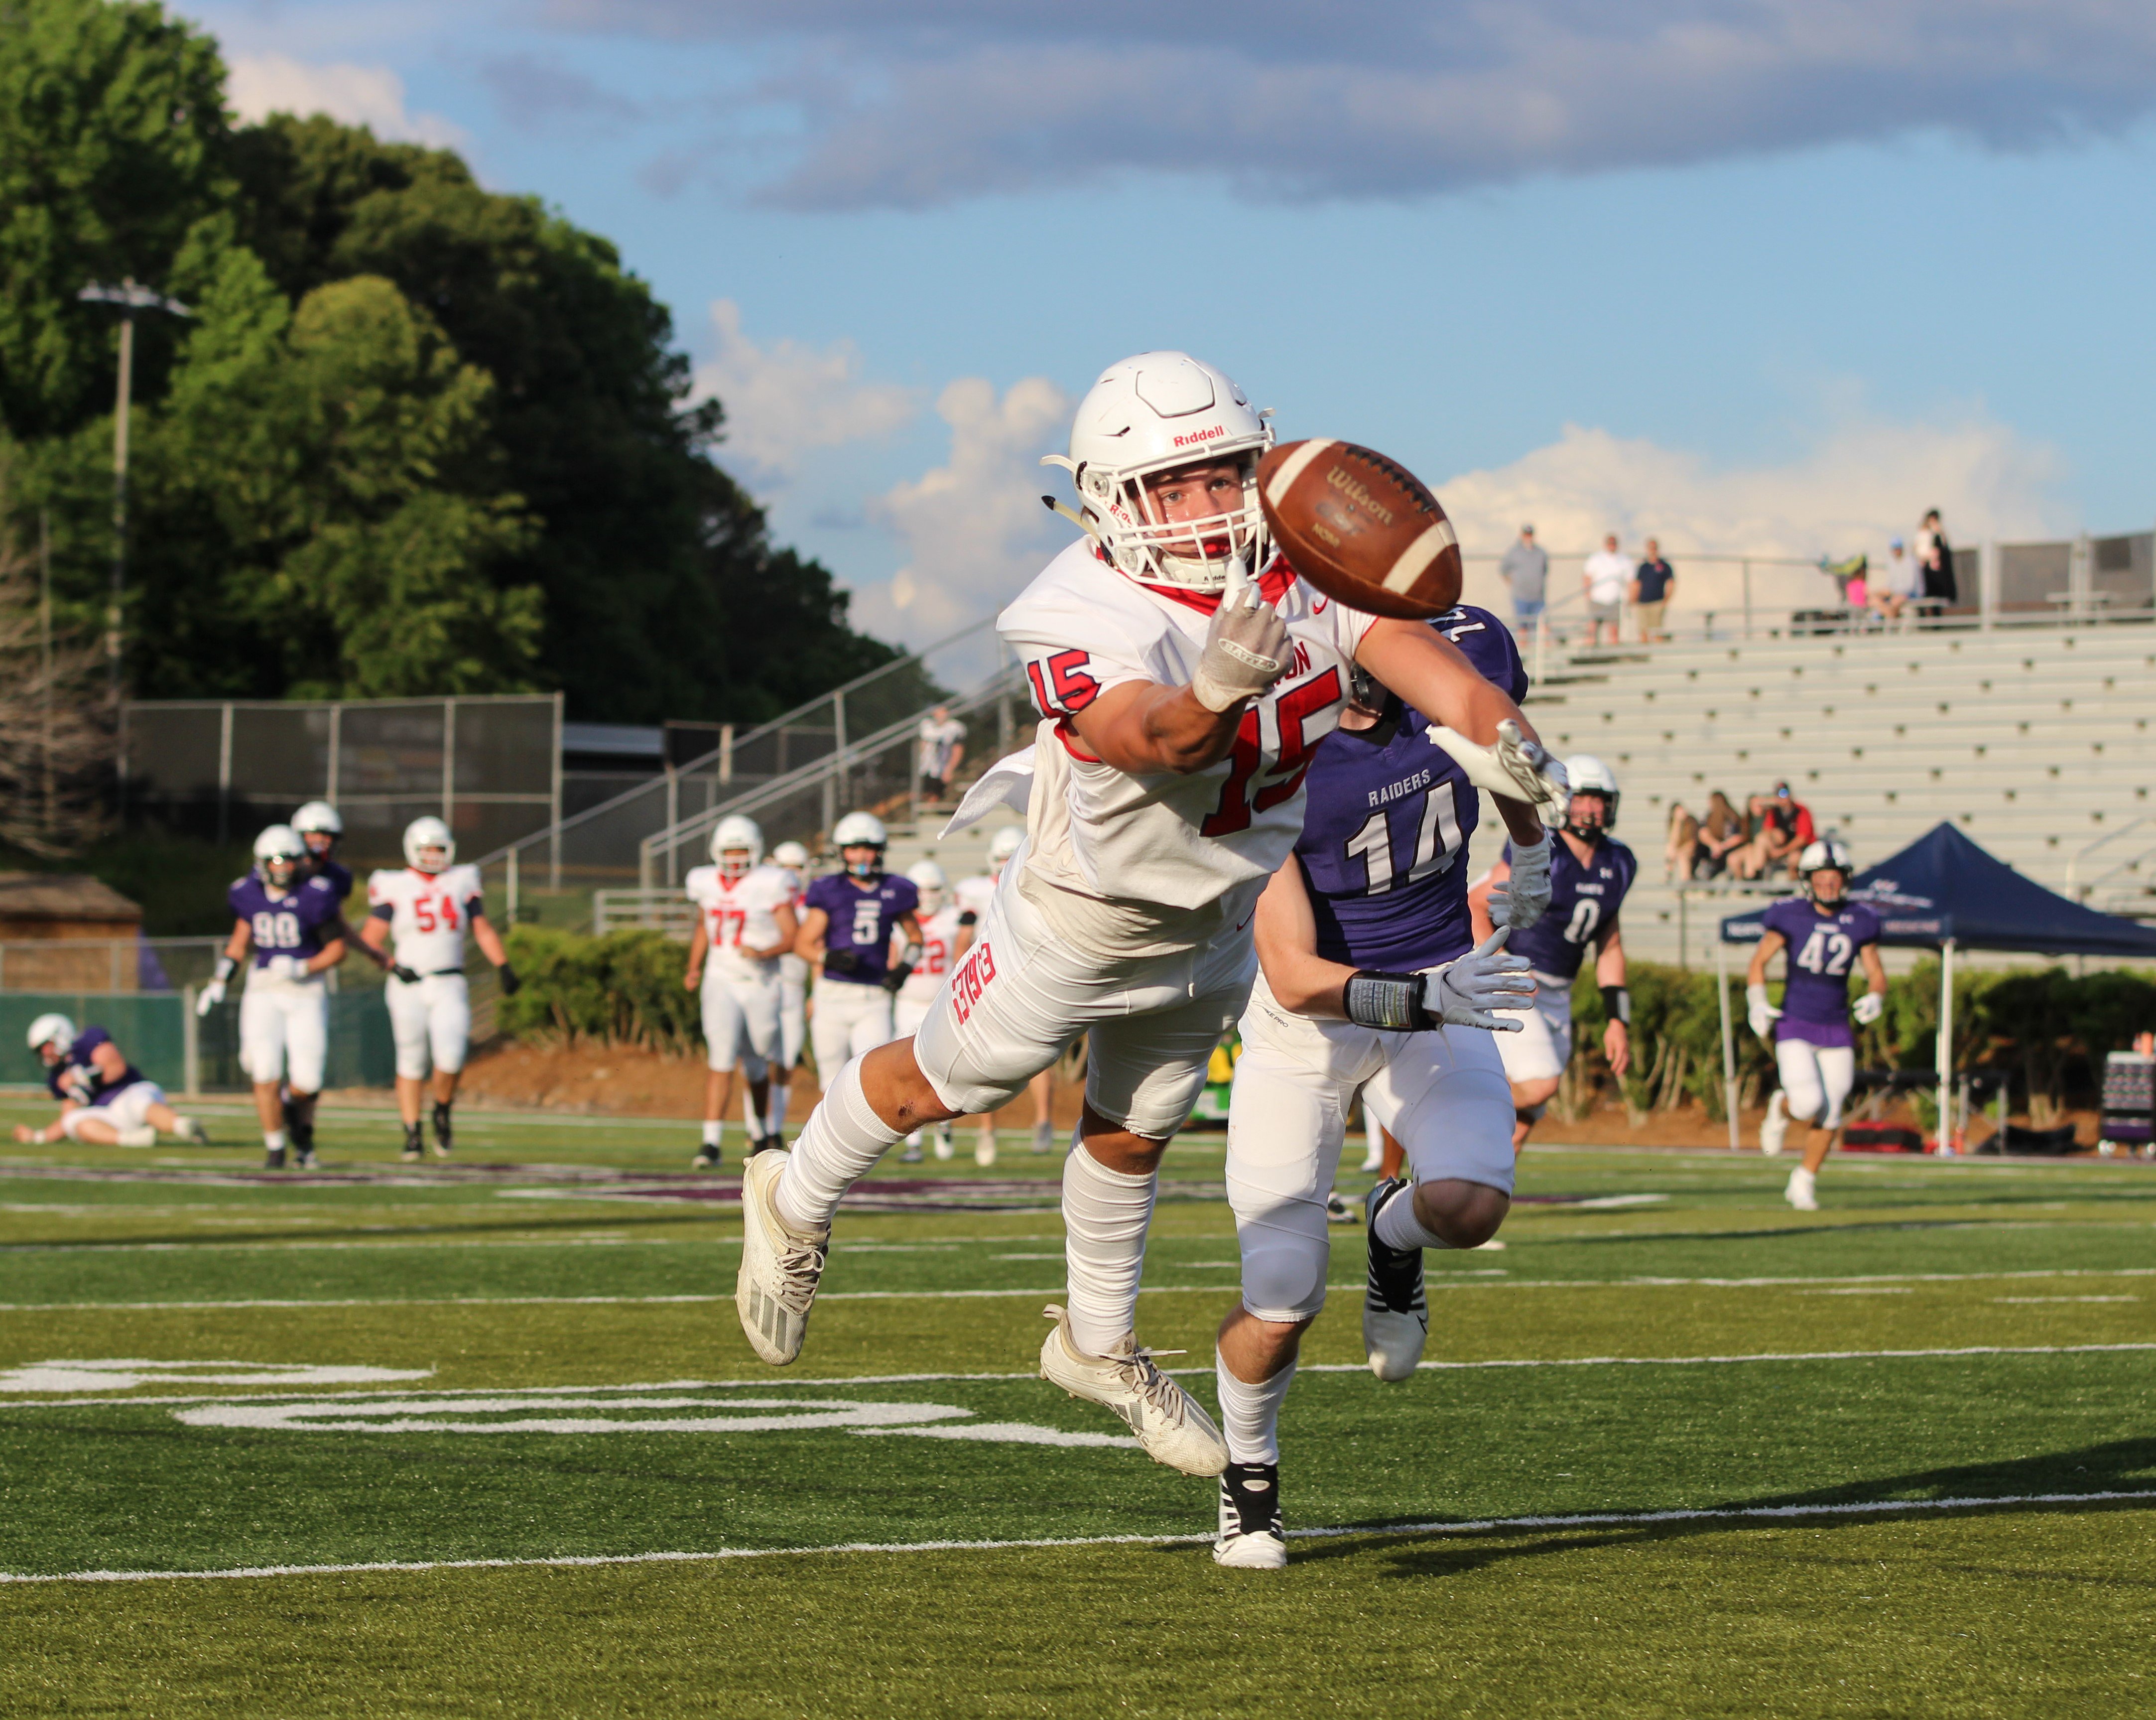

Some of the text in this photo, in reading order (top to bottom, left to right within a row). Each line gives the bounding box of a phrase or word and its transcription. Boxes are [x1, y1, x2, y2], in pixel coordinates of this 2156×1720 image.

[1173, 425, 1224, 447] Riddell
[1326, 465, 1393, 526] Wilson
[1027, 648, 1102, 718] 15
[1199, 664, 1342, 837] 15
[1368, 769, 1431, 807] RAIDERS
[1344, 777, 1463, 896] 14
[415, 895, 458, 932] 54
[710, 910, 746, 946] 77
[852, 910, 880, 945] 5
[1564, 898, 1600, 943] 0
[912, 939, 945, 974] 2
[1796, 932, 1852, 975] 42
[1273, 1016, 1288, 1028] PRO
